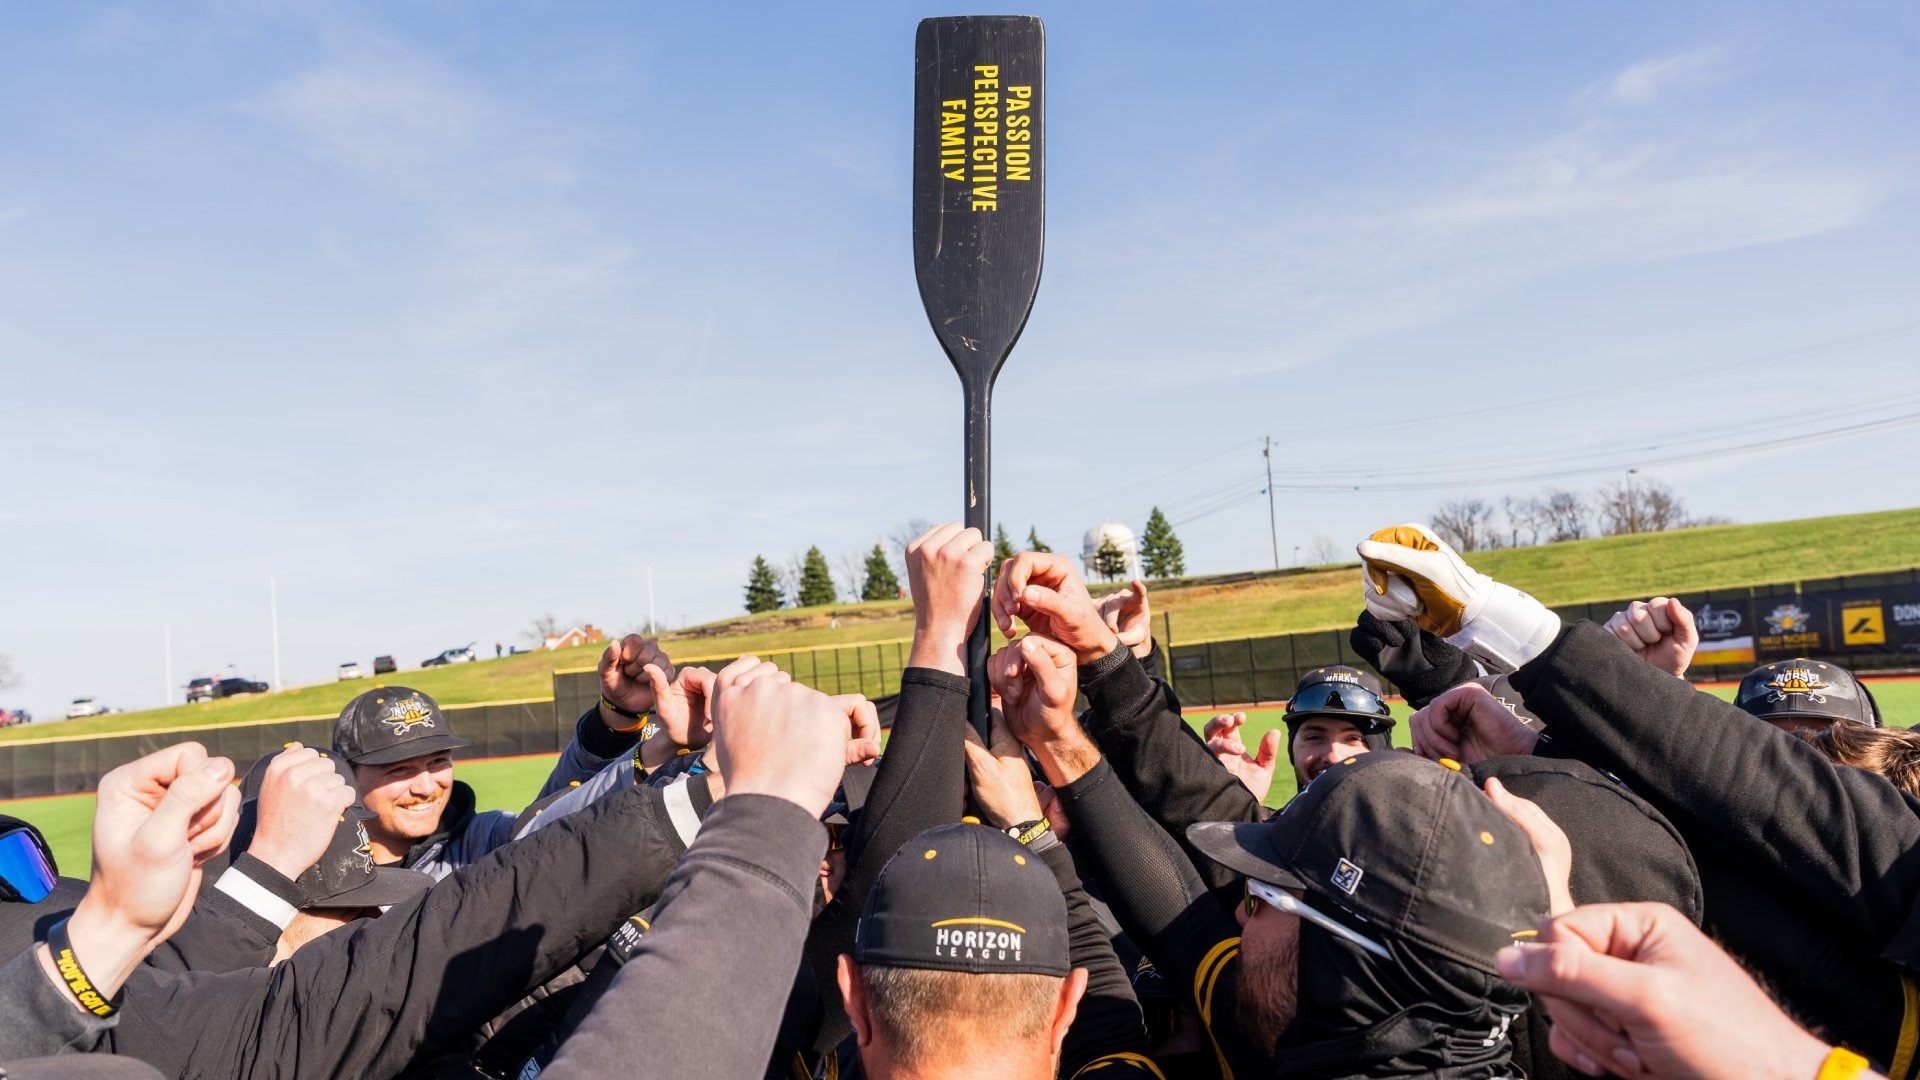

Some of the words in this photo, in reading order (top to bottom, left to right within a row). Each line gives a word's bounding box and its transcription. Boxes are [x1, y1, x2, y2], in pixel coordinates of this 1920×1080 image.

[940, 99, 967, 182] FAMILY
[972, 65, 999, 212] PERSPECTIVE
[1005, 85, 1032, 181] PASSION
[935, 946, 1021, 962] LEAGUE
[936, 929, 1021, 951] HORIZON
